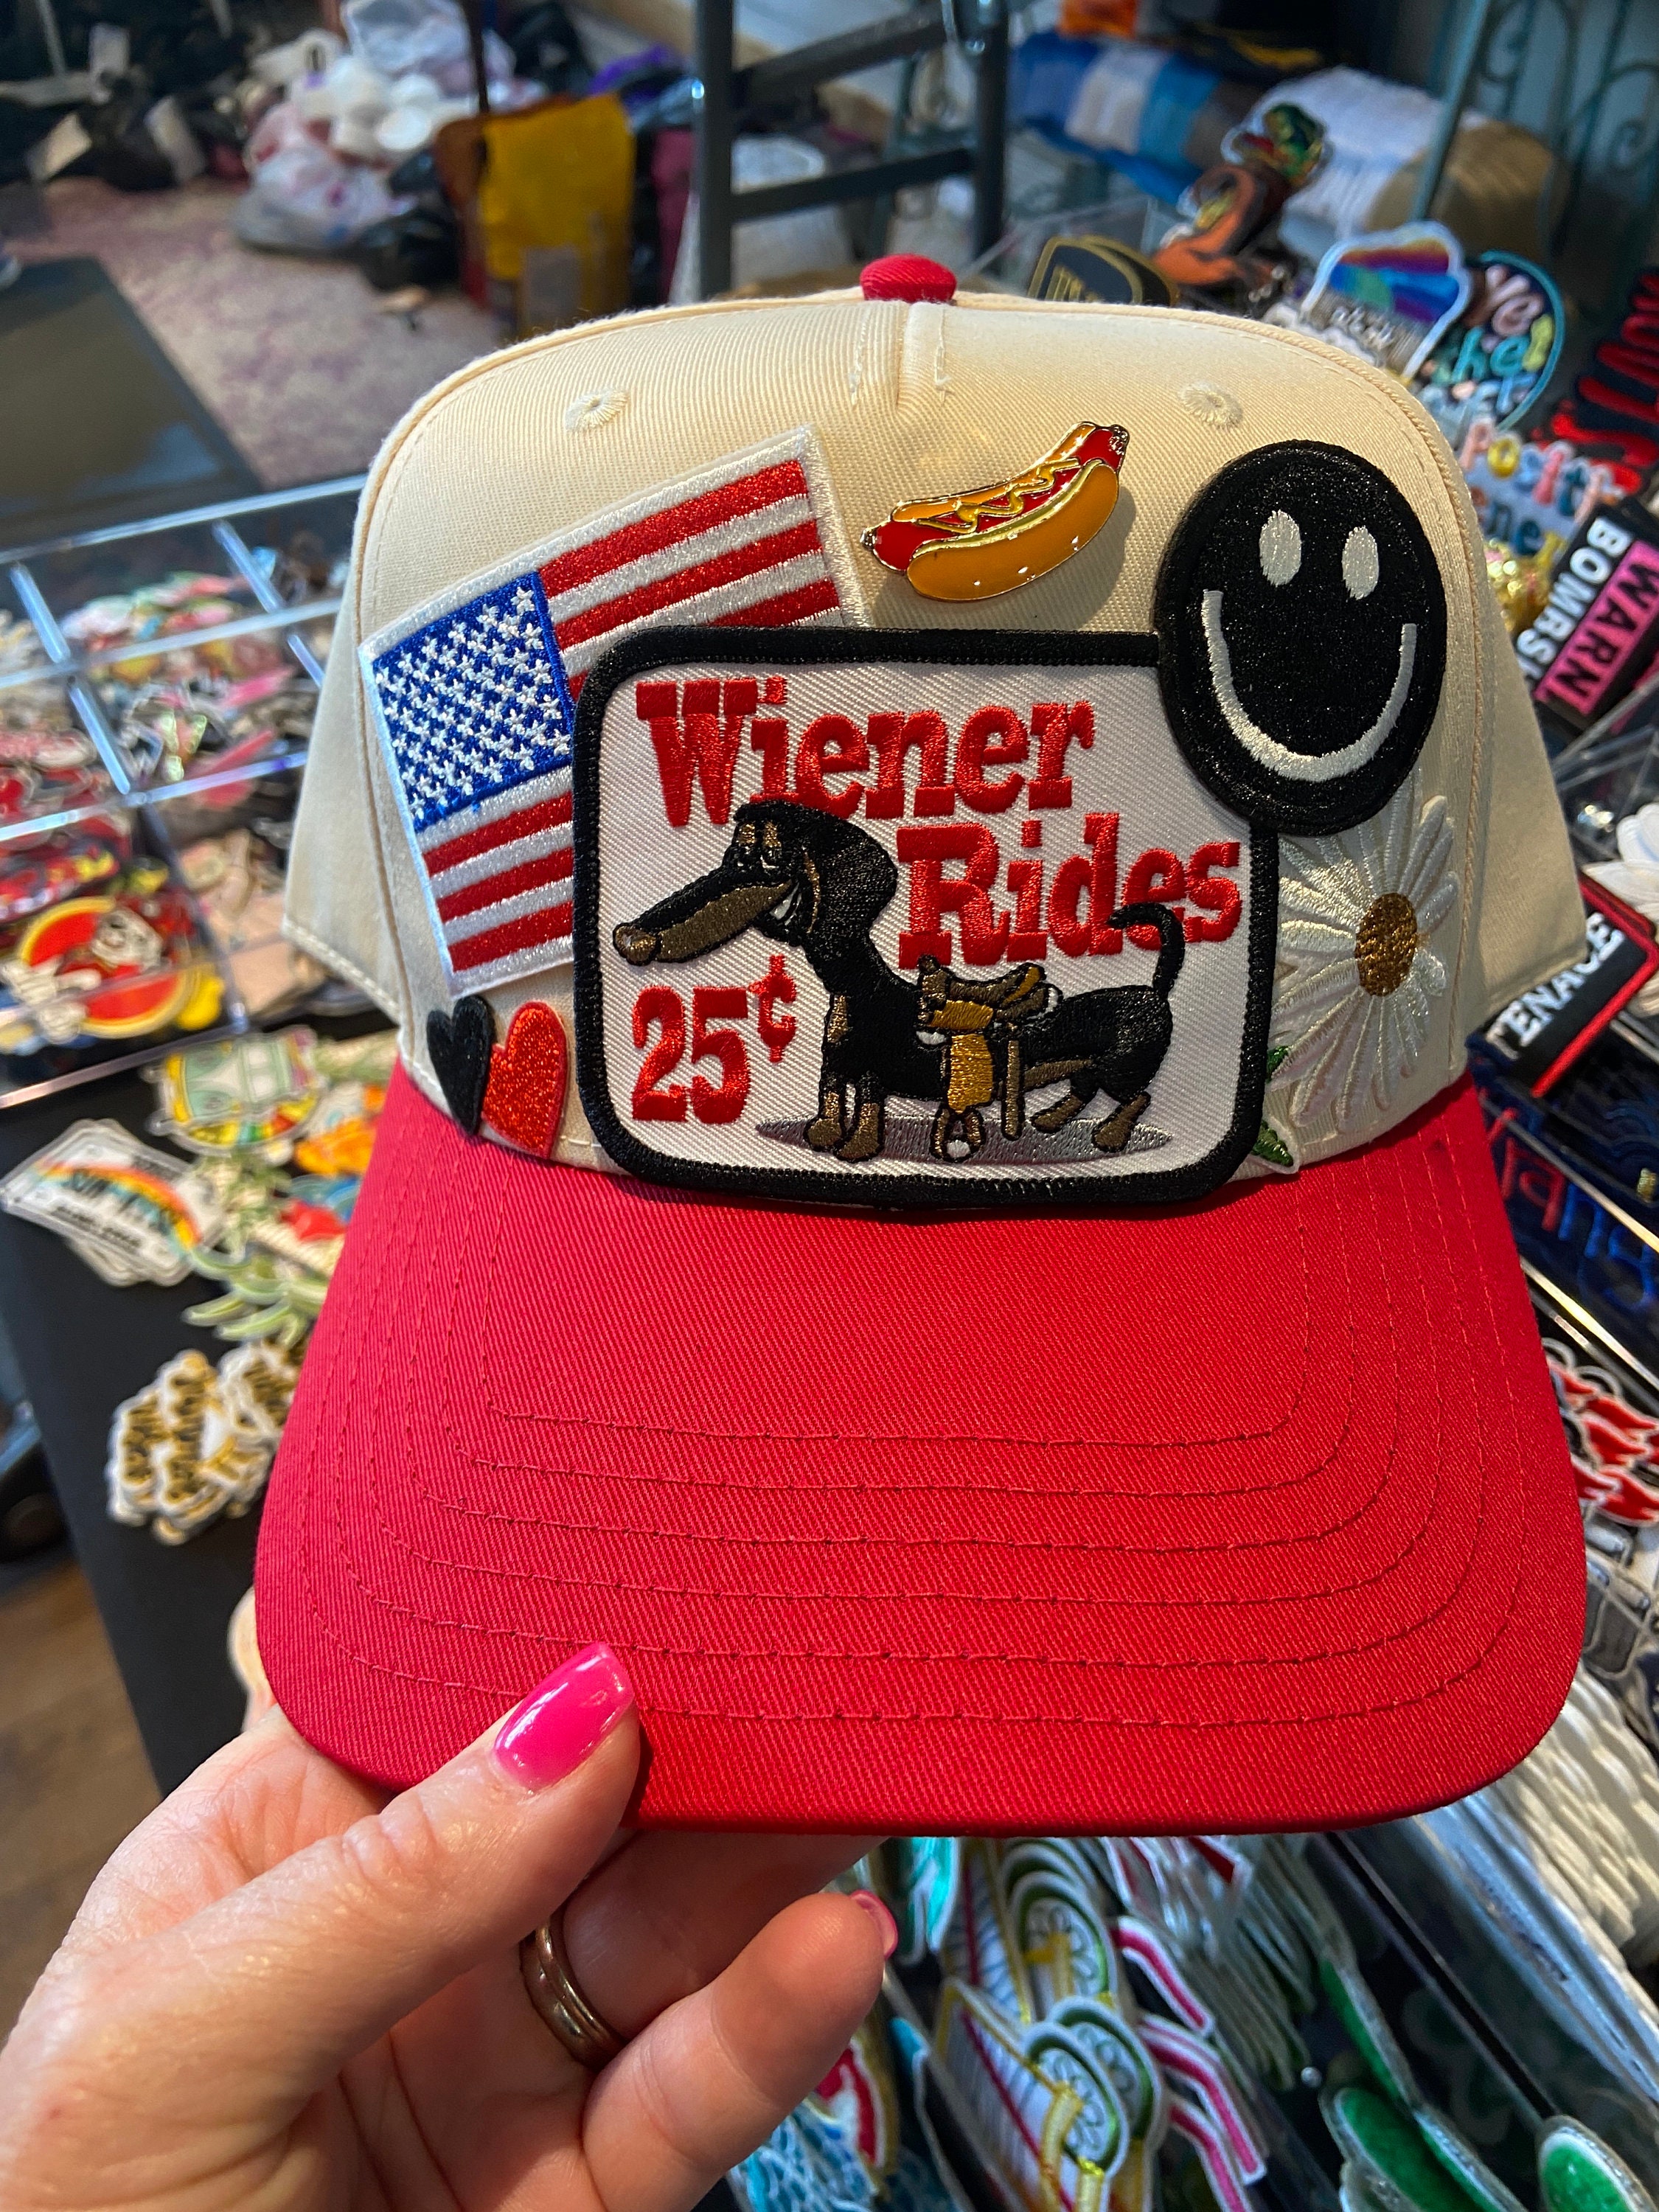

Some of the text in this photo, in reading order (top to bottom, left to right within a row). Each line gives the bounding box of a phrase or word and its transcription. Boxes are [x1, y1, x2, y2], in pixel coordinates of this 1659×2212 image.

[1546, 563, 1659, 700] WARN
[636, 677, 1094, 827] Wiener
[897, 813, 1241, 968] Rides
[632, 956, 796, 1125] 25¢
